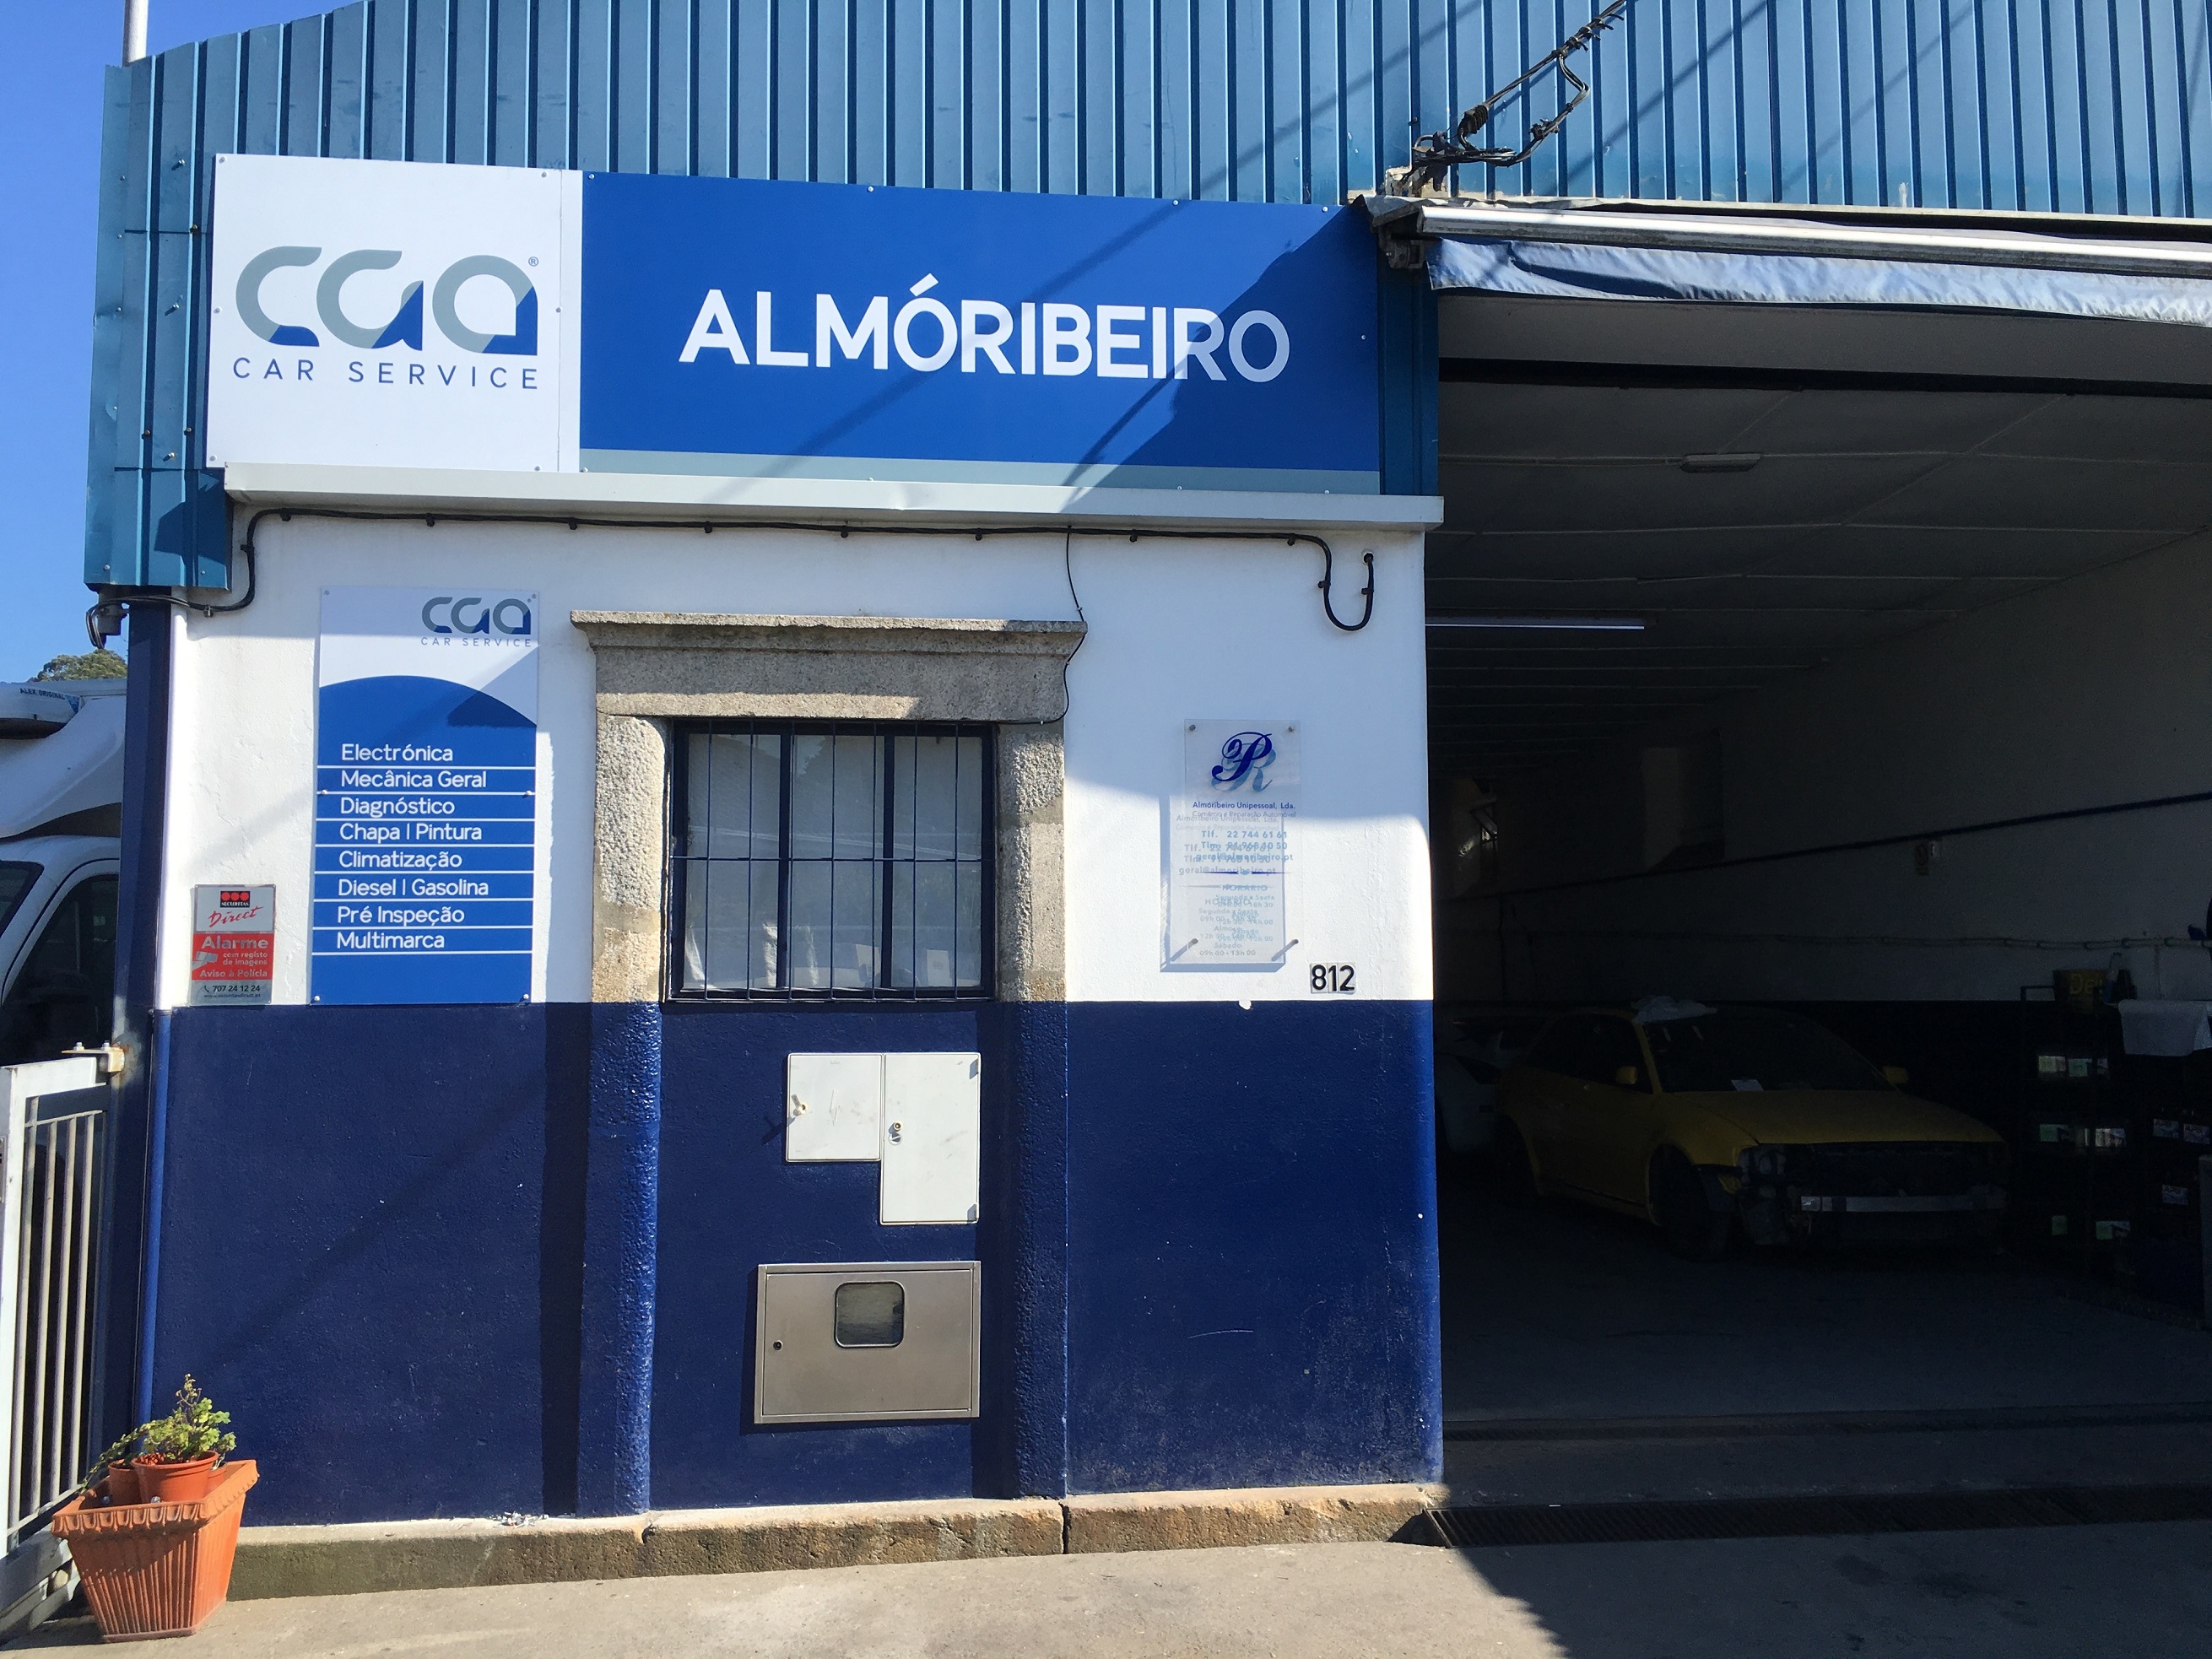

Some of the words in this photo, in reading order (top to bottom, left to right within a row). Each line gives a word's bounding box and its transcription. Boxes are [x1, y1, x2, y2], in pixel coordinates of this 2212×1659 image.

[678, 273, 1290, 383] ALMÓRIBEIRO
[233, 357, 314, 381] CAR
[348, 361, 538, 390] SERVICE
[420, 637, 451, 646] CAR
[462, 638, 531, 647] SERVICE
[341, 743, 453, 761] Electrónica
[341, 770, 433, 787] Mecânica
[437, 770, 487, 788] Geral
[340, 797, 455, 819] Diagnóstico
[339, 823, 400, 844] Chapa
[416, 823, 482, 840] Pintura
[338, 850, 462, 871] Climatização
[338, 878, 397, 896] Diesel
[411, 878, 489, 896] Gasolina
[208, 905, 264, 927] Direct
[338, 905, 373, 923] Pré
[377, 905, 465, 927] Inspeção
[201, 935, 268, 948] Alarme
[337, 932, 445, 948] Multimarca
[241, 951, 268, 959] registo
[1312, 964, 1355, 992] 812
